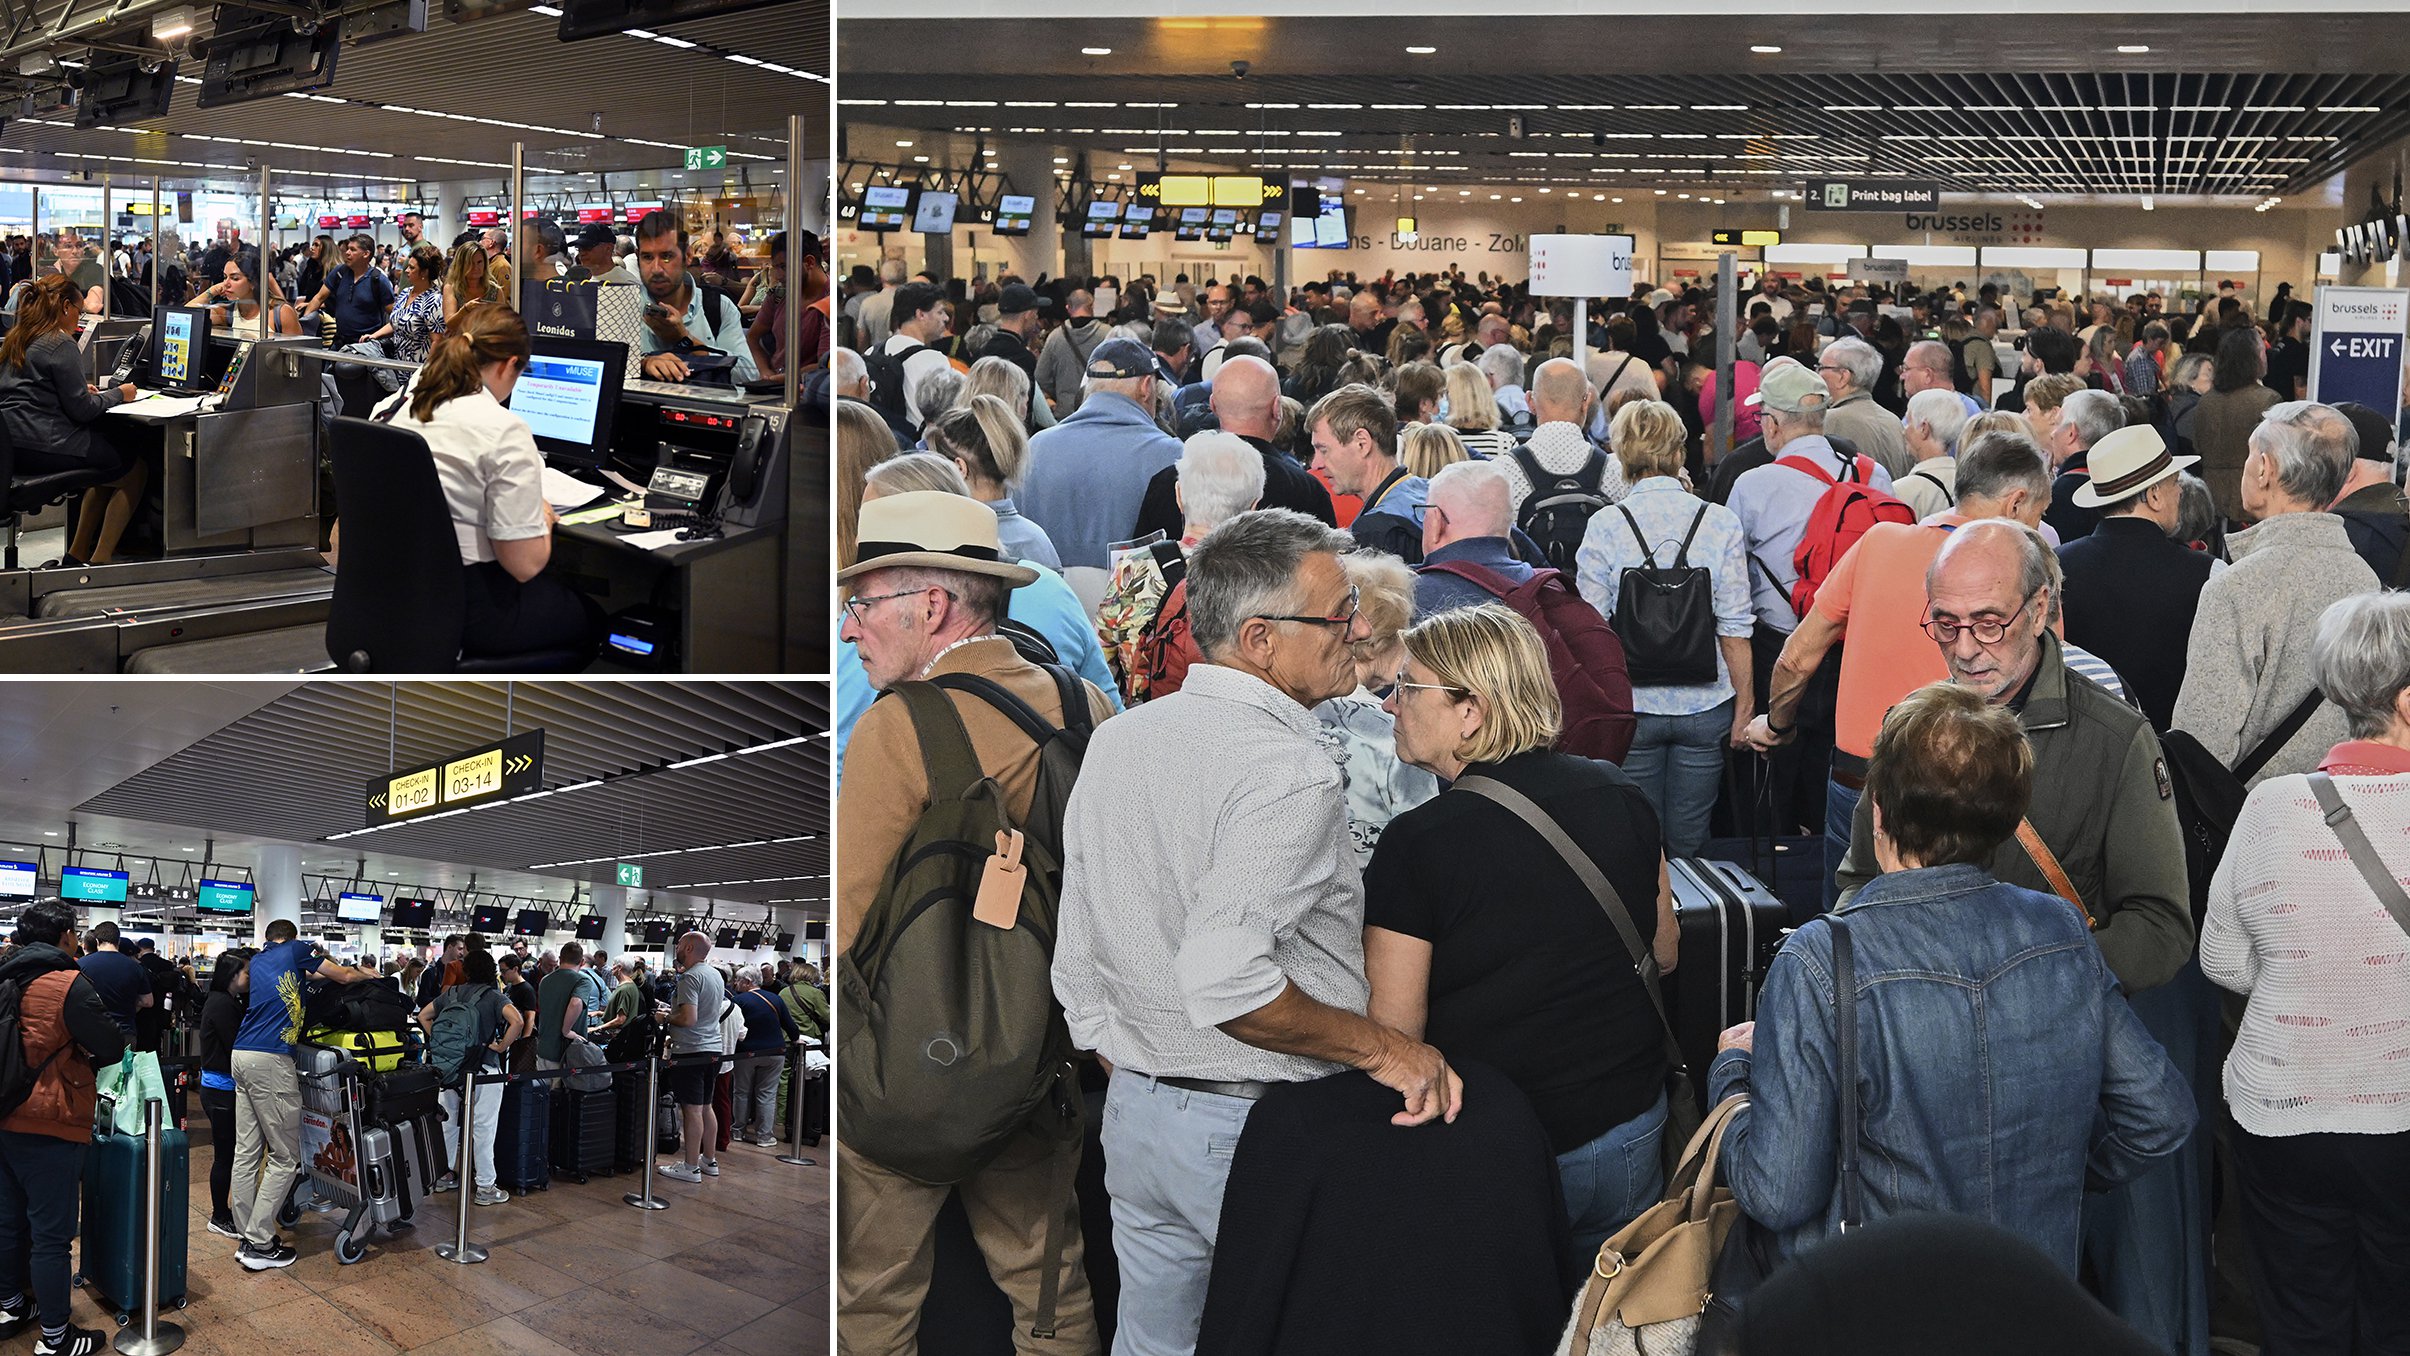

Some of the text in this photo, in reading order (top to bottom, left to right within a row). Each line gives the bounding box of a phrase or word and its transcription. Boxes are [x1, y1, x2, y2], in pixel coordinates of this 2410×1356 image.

[1810, 189, 1932, 204] 2. Print bag label
[1906, 212, 2003, 231] brussels
[2332, 303, 2378, 314] brussels
[536, 321, 576, 338] Leonidas
[2349, 337, 2395, 358] EXIT
[565, 365, 594, 377] vMUSE
[769, 415, 780, 427] 15
[454, 756, 494, 776] CHECK-IN
[395, 774, 430, 791] CHECK-IN
[452, 771, 492, 795] 03-14
[395, 787, 430, 809] 01-02
[82, 881, 109, 889] ECONOMY
[136, 886, 154, 897] 2.4
